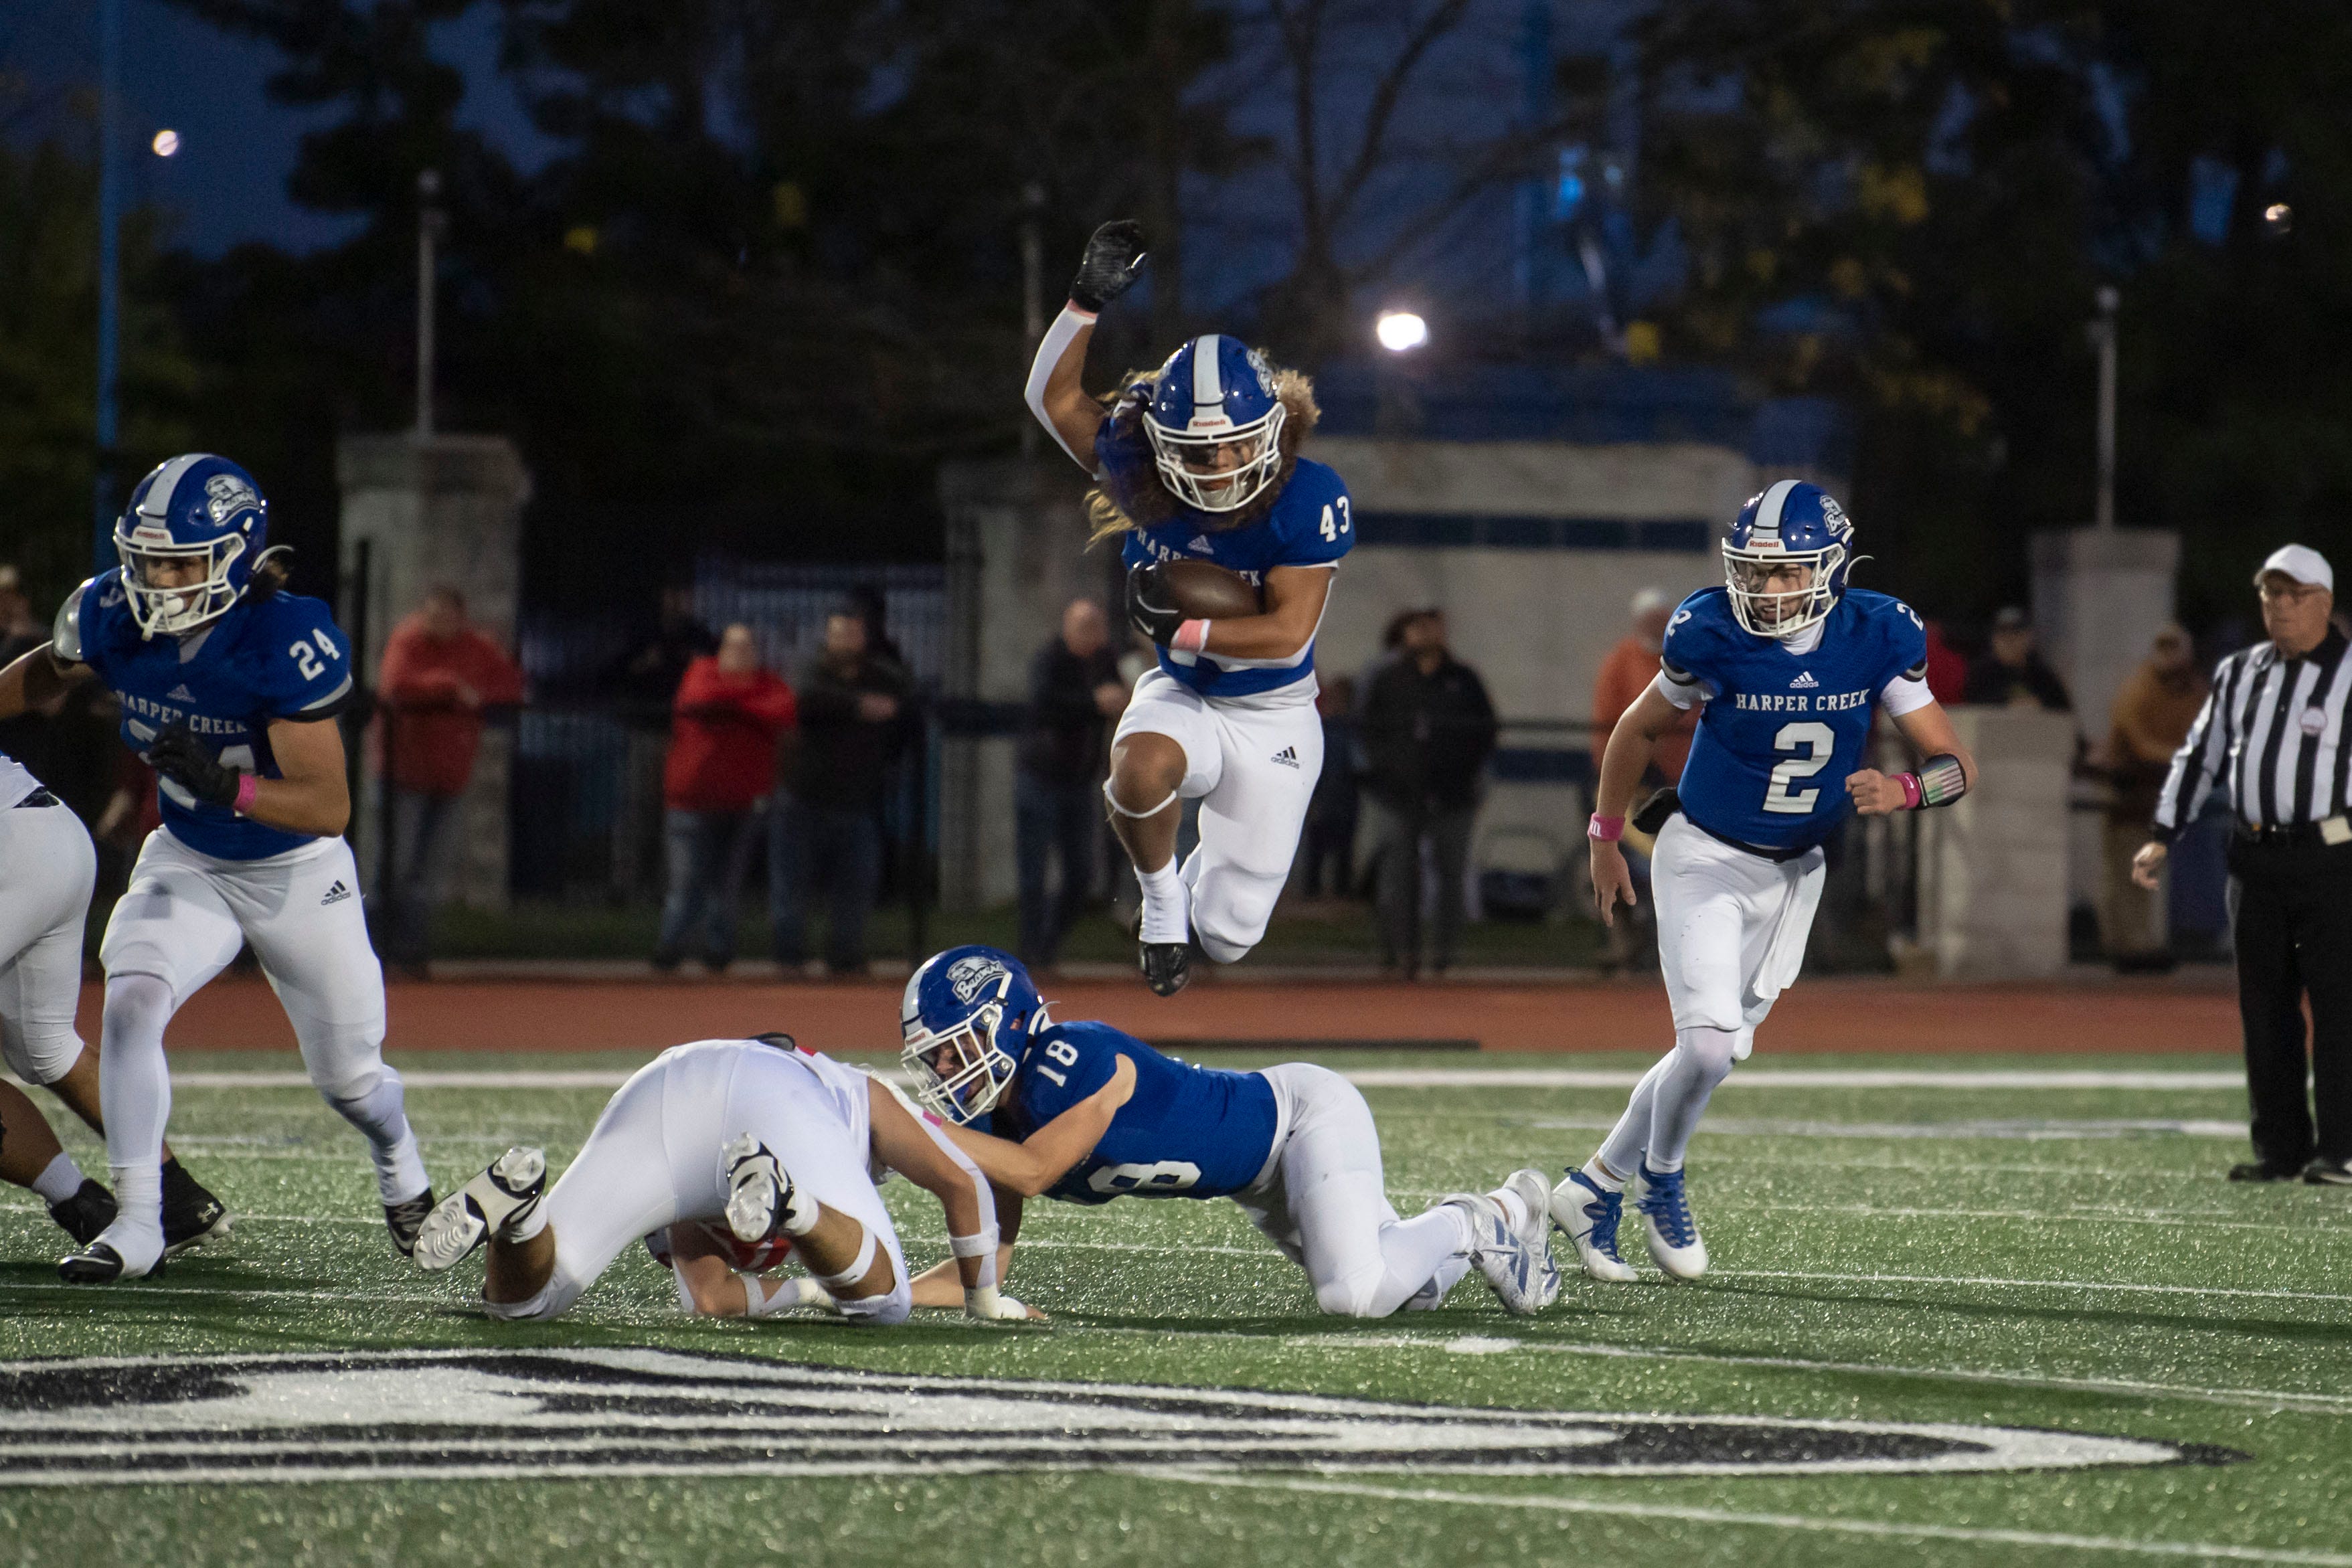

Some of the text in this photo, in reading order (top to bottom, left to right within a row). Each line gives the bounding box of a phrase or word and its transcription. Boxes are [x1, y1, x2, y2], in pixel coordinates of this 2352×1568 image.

[1320, 496, 1349, 543] 43
[1137, 527, 1189, 562] HARP
[1668, 610, 1692, 636] 2
[1896, 603, 1924, 631] 2
[289, 628, 340, 681] 24
[1736, 689, 1870, 711] HARPER CREEK
[1789, 681, 1819, 689] adidas
[1762, 722, 1835, 813] 2
[1037, 1039, 1078, 1087] 18
